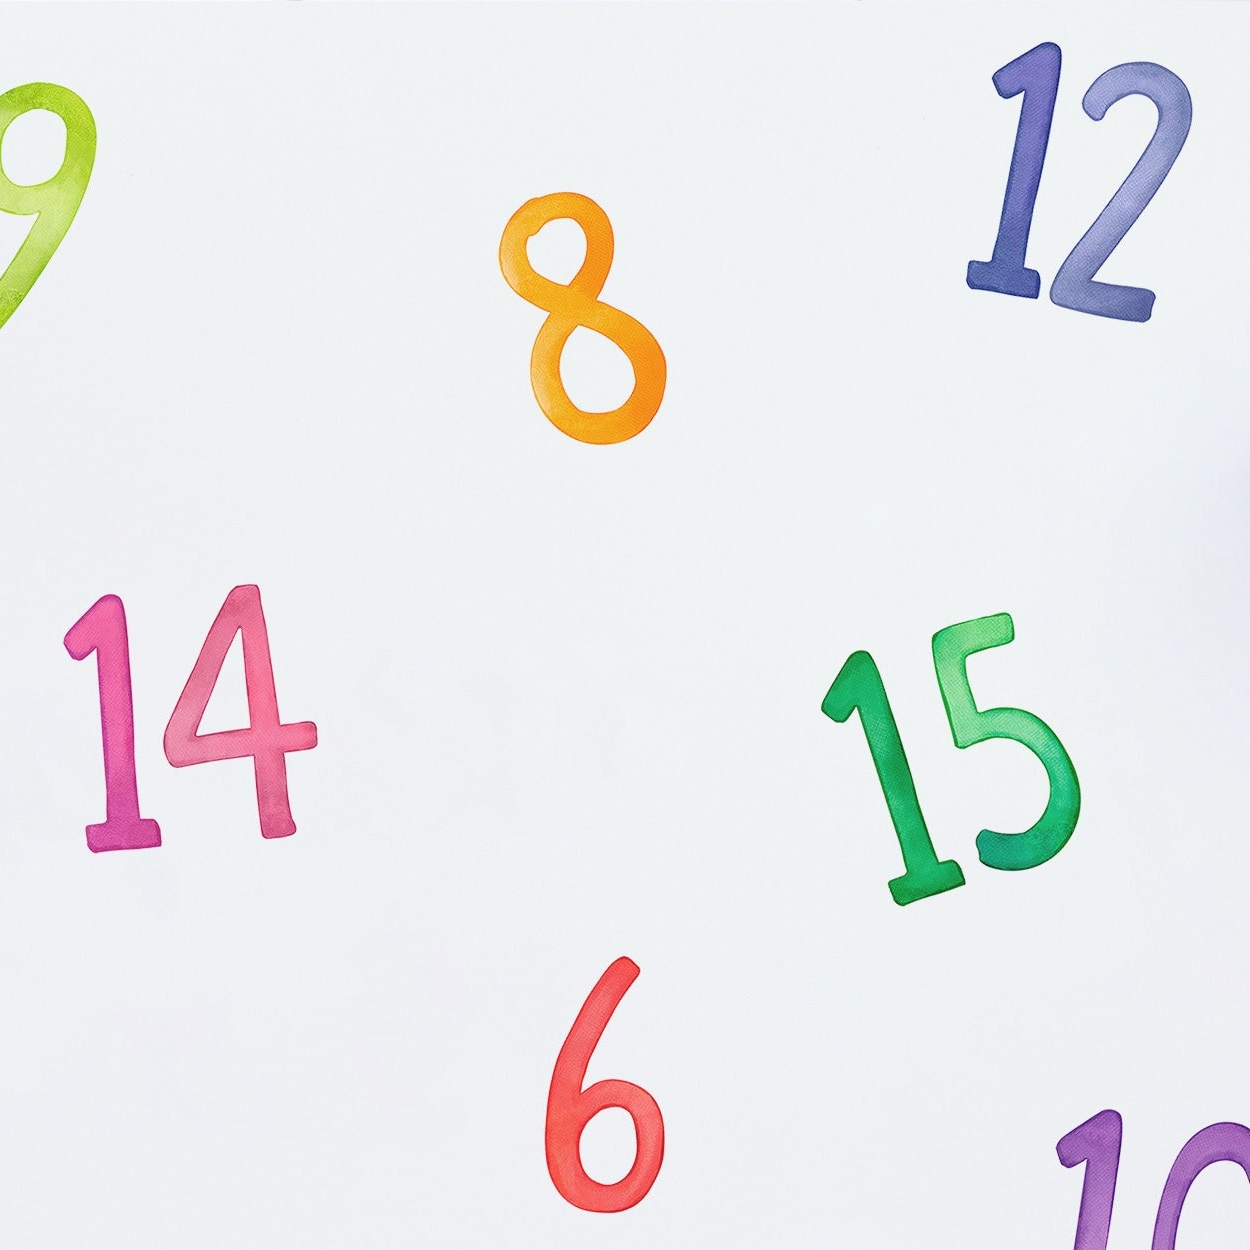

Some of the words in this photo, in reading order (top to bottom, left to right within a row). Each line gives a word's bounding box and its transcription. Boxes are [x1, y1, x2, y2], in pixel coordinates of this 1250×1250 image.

[966, 42, 1193, 323] 12
[498, 192, 668, 446] 8
[63, 583, 319, 853] 14
[820, 612, 1082, 906] 15
[544, 956, 666, 1214] 6
